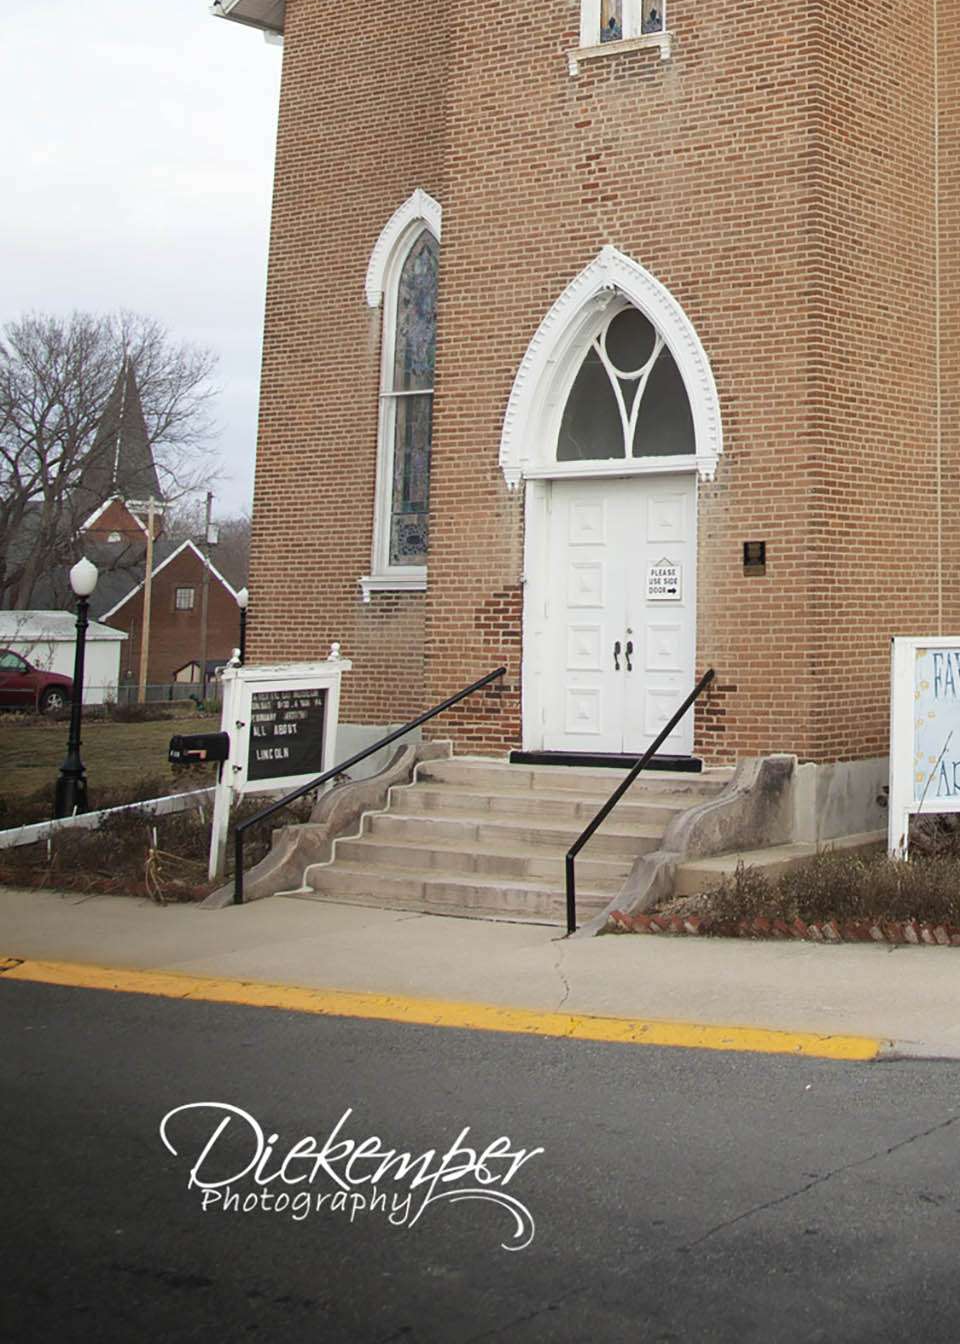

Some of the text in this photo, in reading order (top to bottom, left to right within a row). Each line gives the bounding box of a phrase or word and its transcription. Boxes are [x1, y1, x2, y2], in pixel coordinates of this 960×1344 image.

[650, 568, 676, 577] PLEASE
[649, 577, 678, 585] USE SIDE
[648, 586, 666, 594] DOOR
[253, 723, 298, 737] ALL ABOUT
[256, 747, 289, 761] LINCOLN
